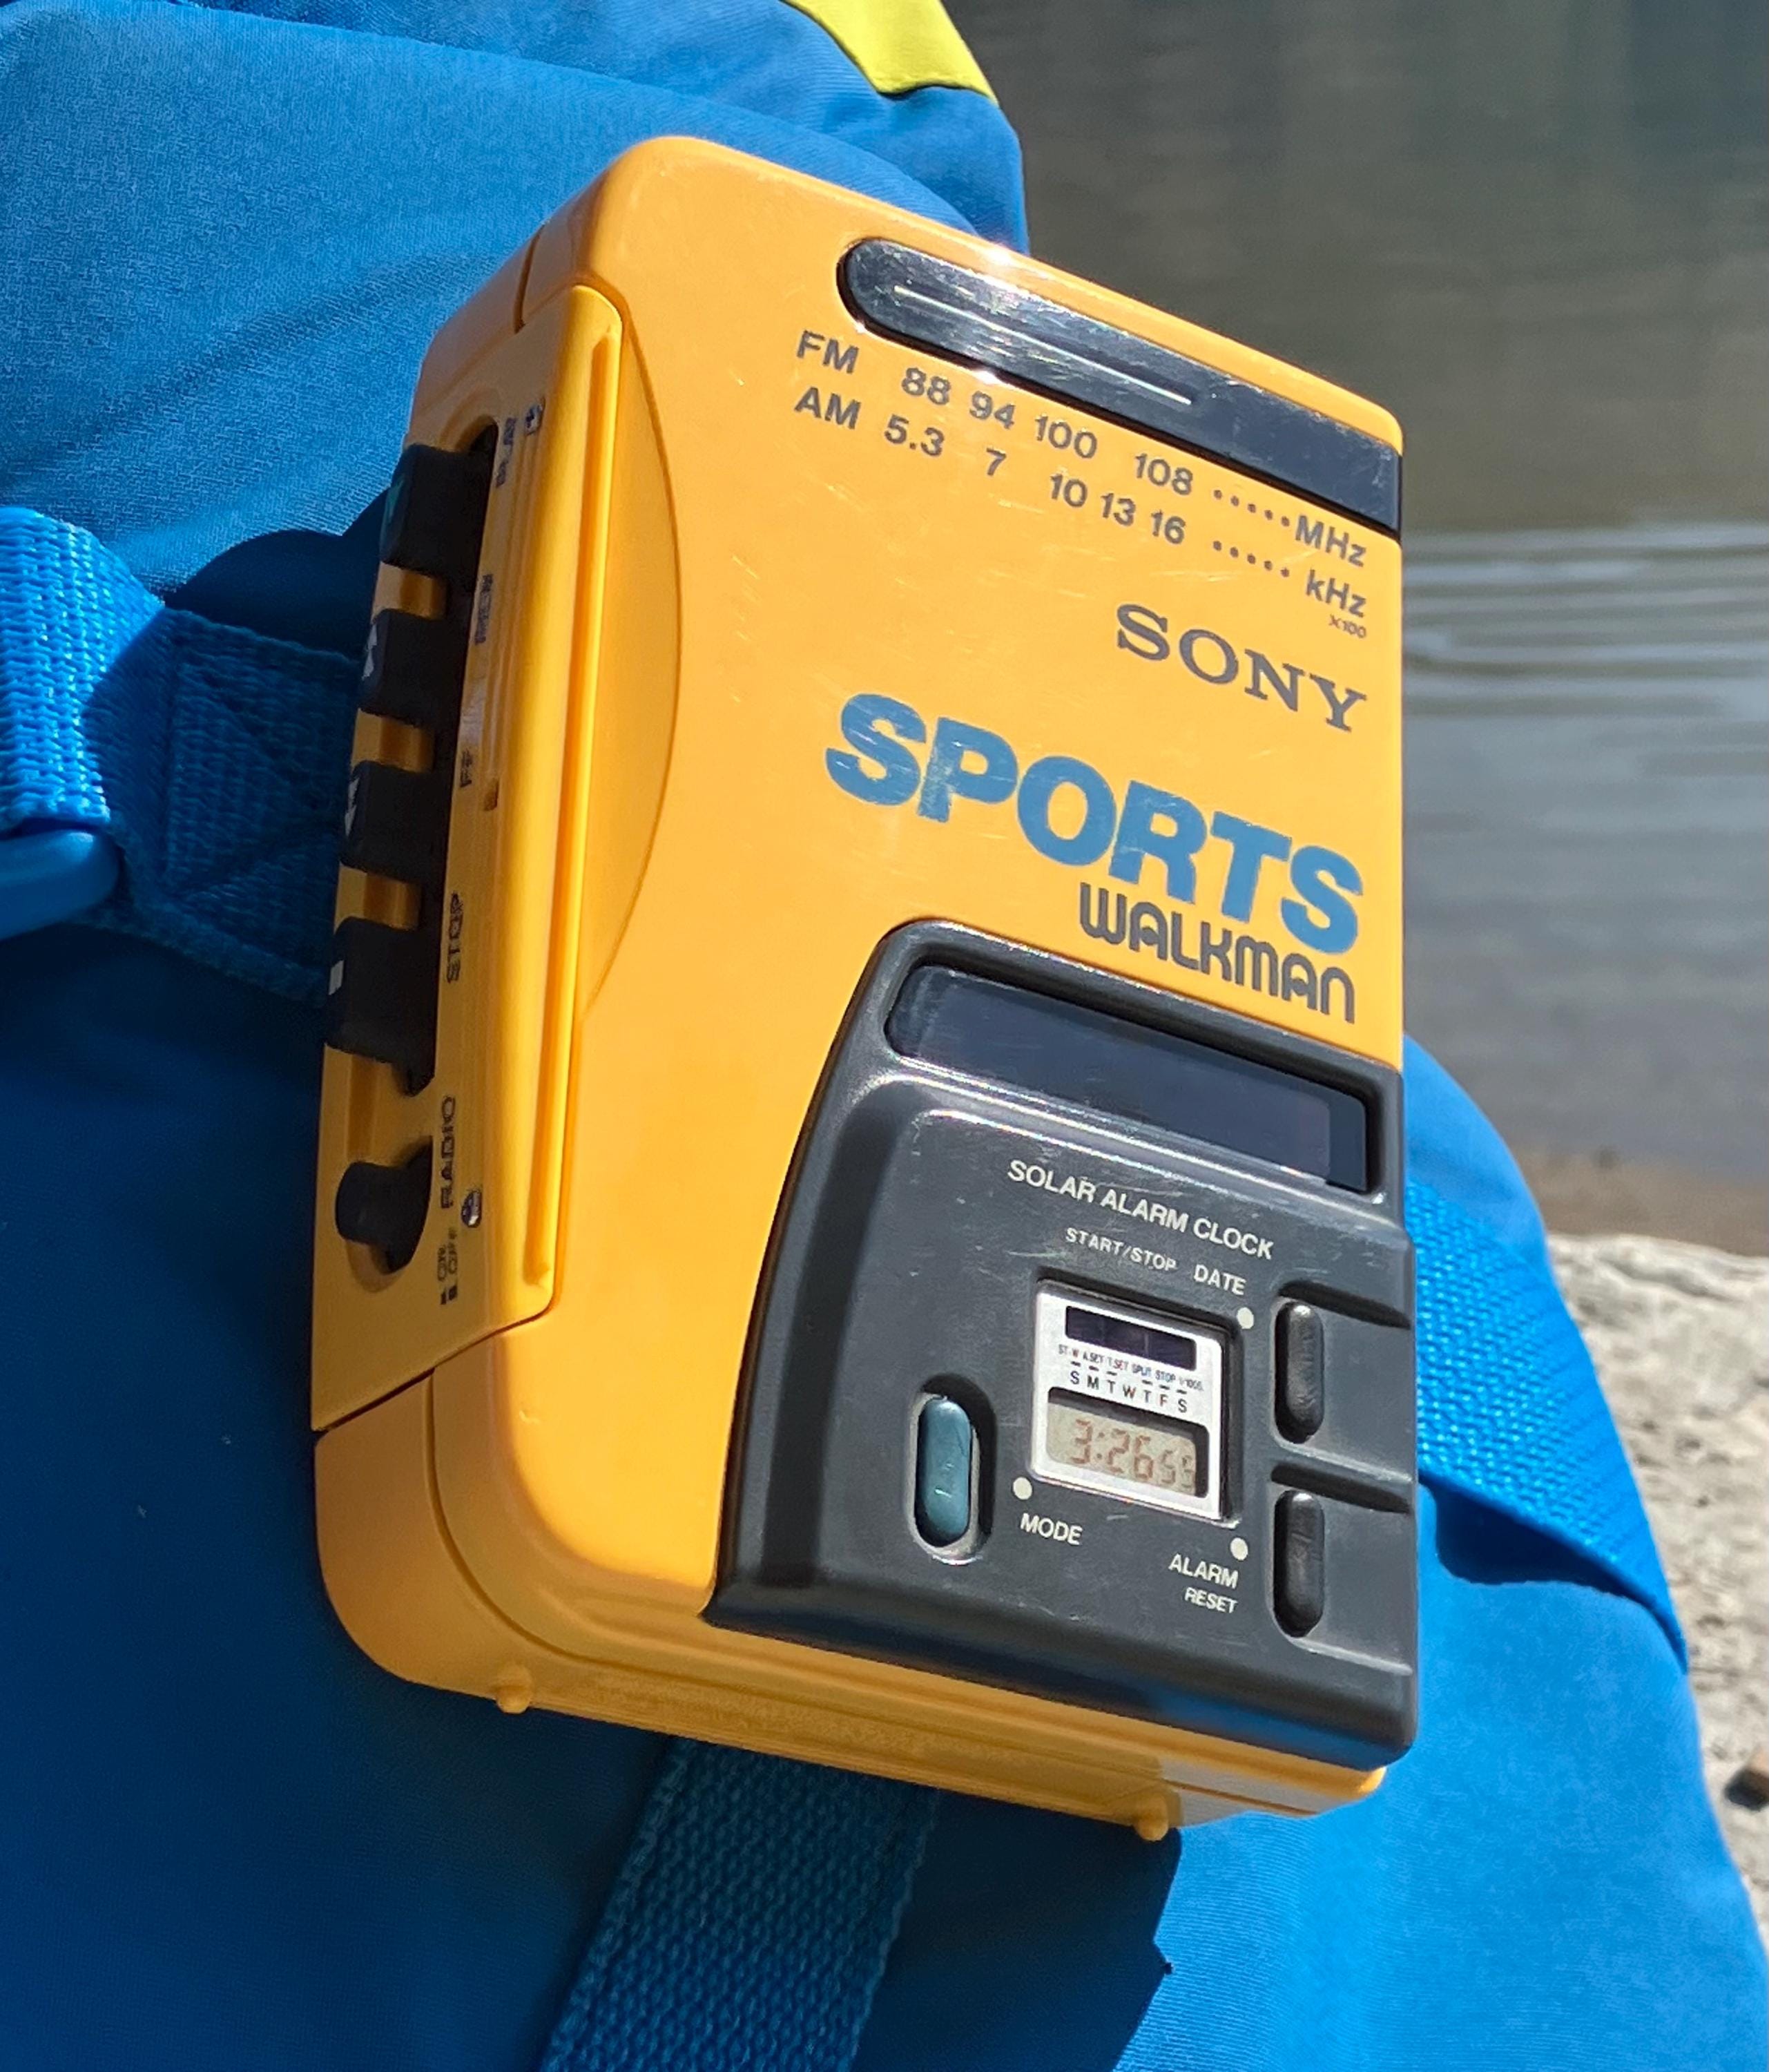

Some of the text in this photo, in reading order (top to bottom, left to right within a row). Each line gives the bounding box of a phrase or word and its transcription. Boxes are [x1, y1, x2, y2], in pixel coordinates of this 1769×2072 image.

[796, 330, 1367, 567] FM 88 94 100 108 MHz
[794, 387, 1367, 617] AM 5.3 7 10 13 16 kHz
[1117, 604, 1366, 732] SONY
[825, 693, 1363, 955] SPORTS
[1079, 883, 1355, 1024] WALKMAN
[441, 1095, 456, 1209] RADIO
[1007, 1160, 1274, 1260] SOLAR ALARM CLOCK
[1065, 1227, 1246, 1296] START/STOP DATE
[1070, 1371, 1187, 1413] S M T W T F S
[1155, 1370, 1176, 1383] STOP
[1020, 1513, 1083, 1546] MODE
[1168, 1553, 1239, 1589] ALARM
[1185, 1587, 1237, 1614] RESET
